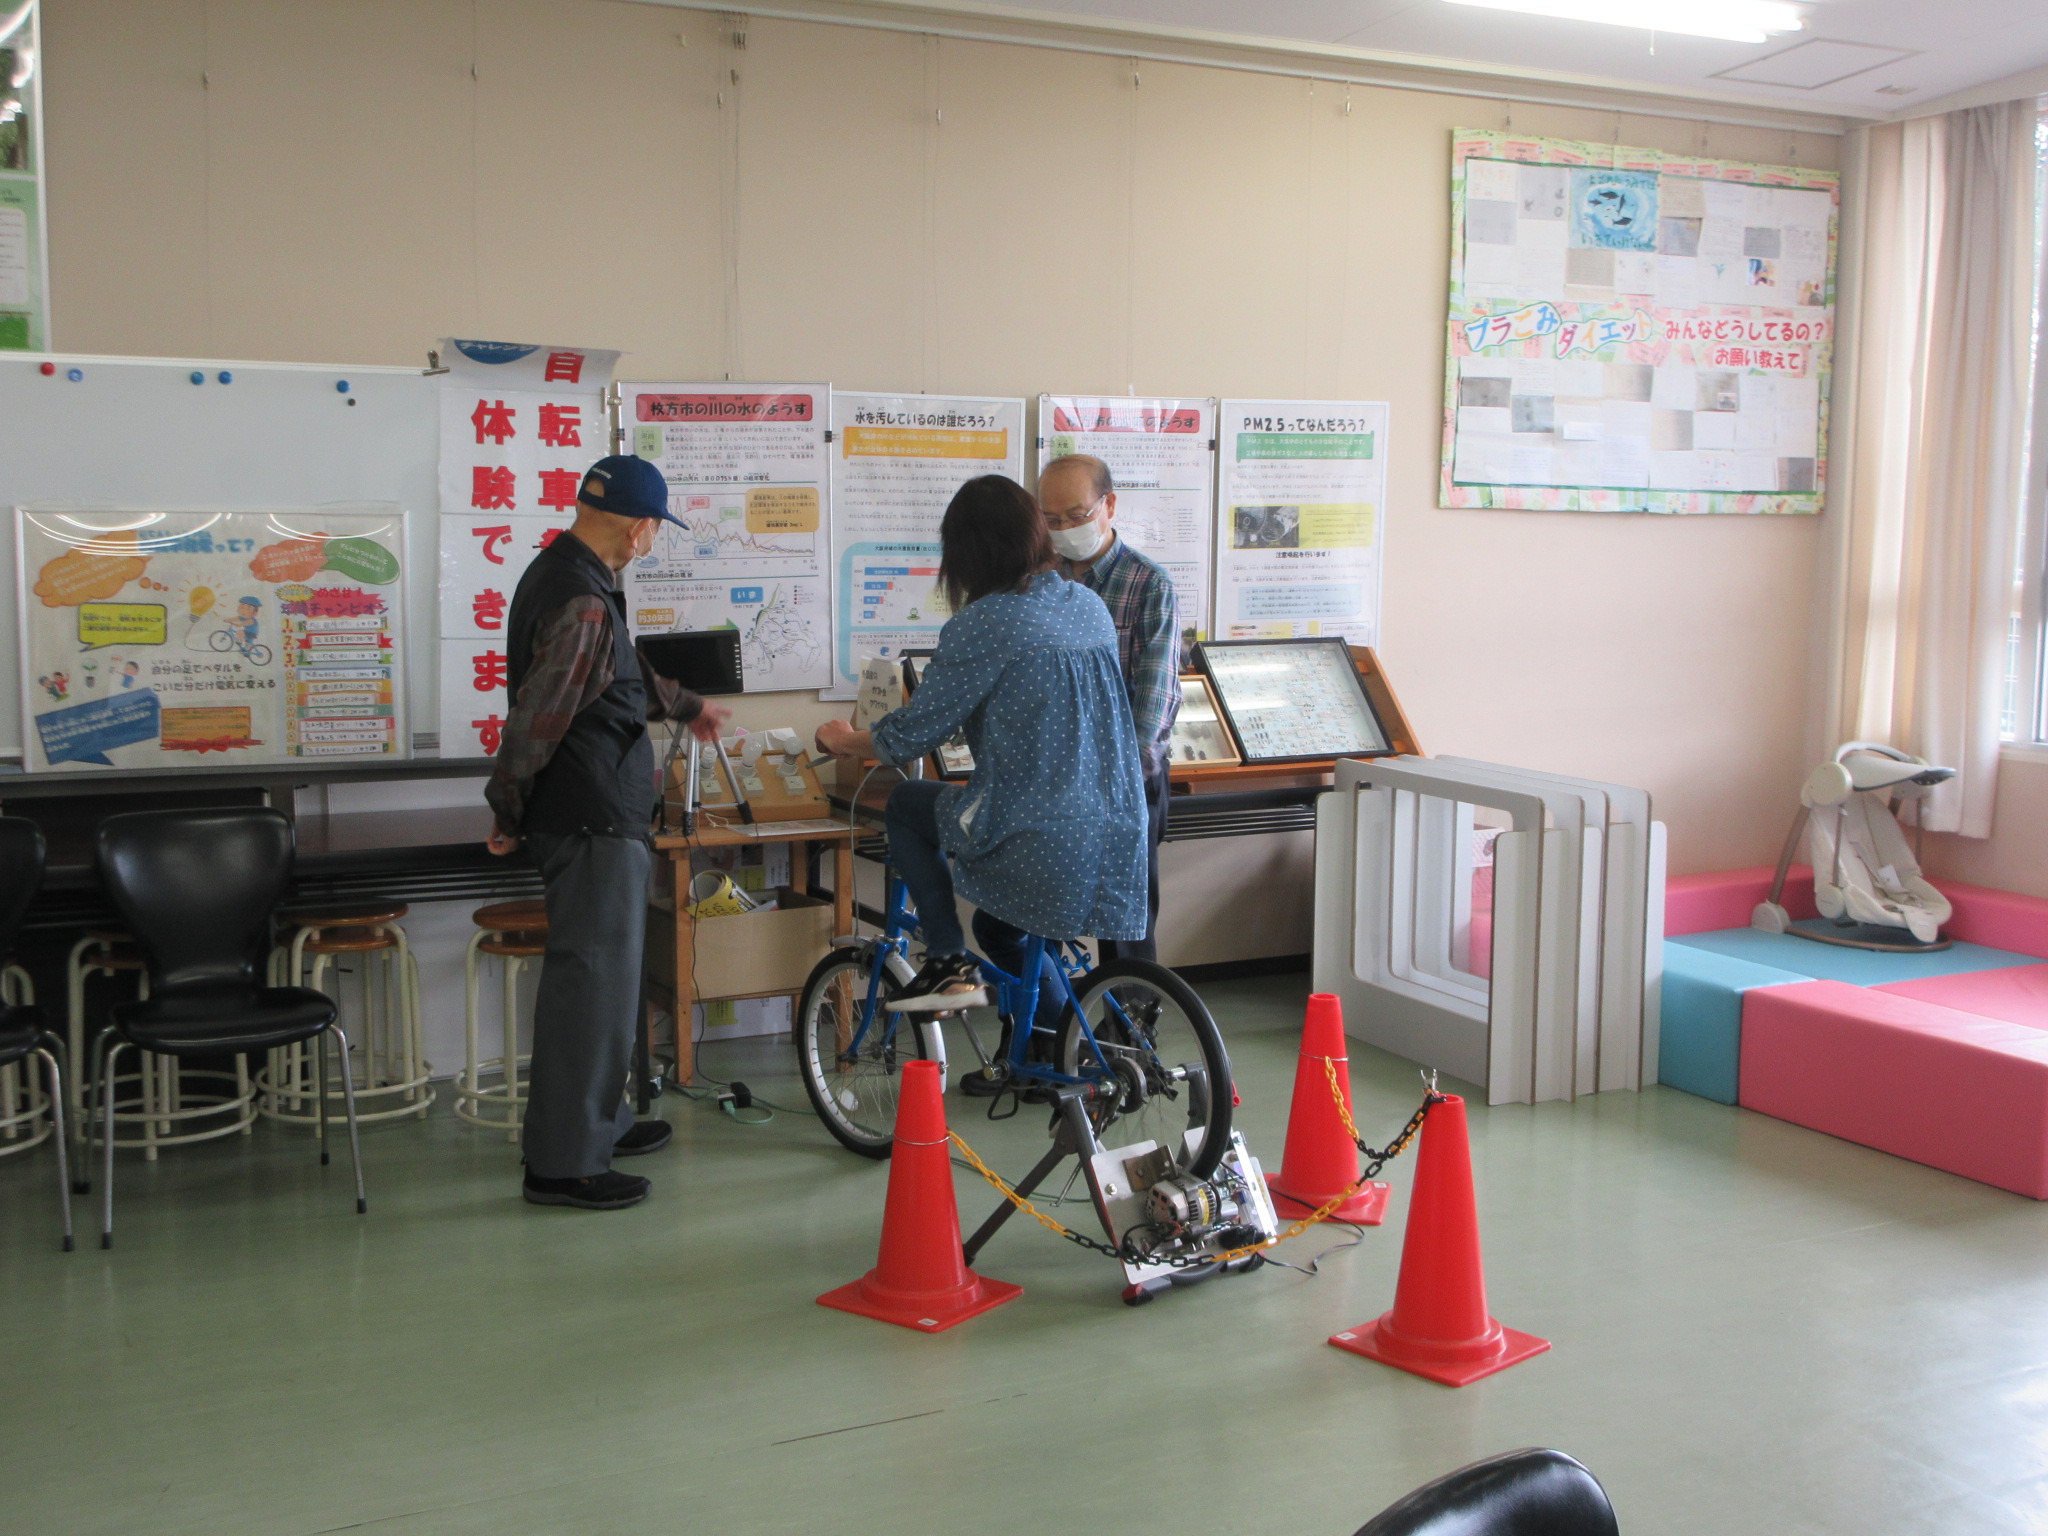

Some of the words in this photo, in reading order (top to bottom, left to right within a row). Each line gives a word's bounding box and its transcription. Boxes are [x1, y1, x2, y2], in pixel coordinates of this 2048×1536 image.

[1558, 310, 1651, 357] ダイエット
[1665, 319, 1824, 341] みんなどうしてるの？
[1715, 347, 1800, 369] お願い教えて
[650, 402, 808, 416] 枚方市の川の水のようす
[855, 411, 995, 428] 水を汚しているのは誰だろう？
[1243, 417, 1366, 432] PM2.5ってなんだろう？
[470, 399, 518, 757] 体験できます
